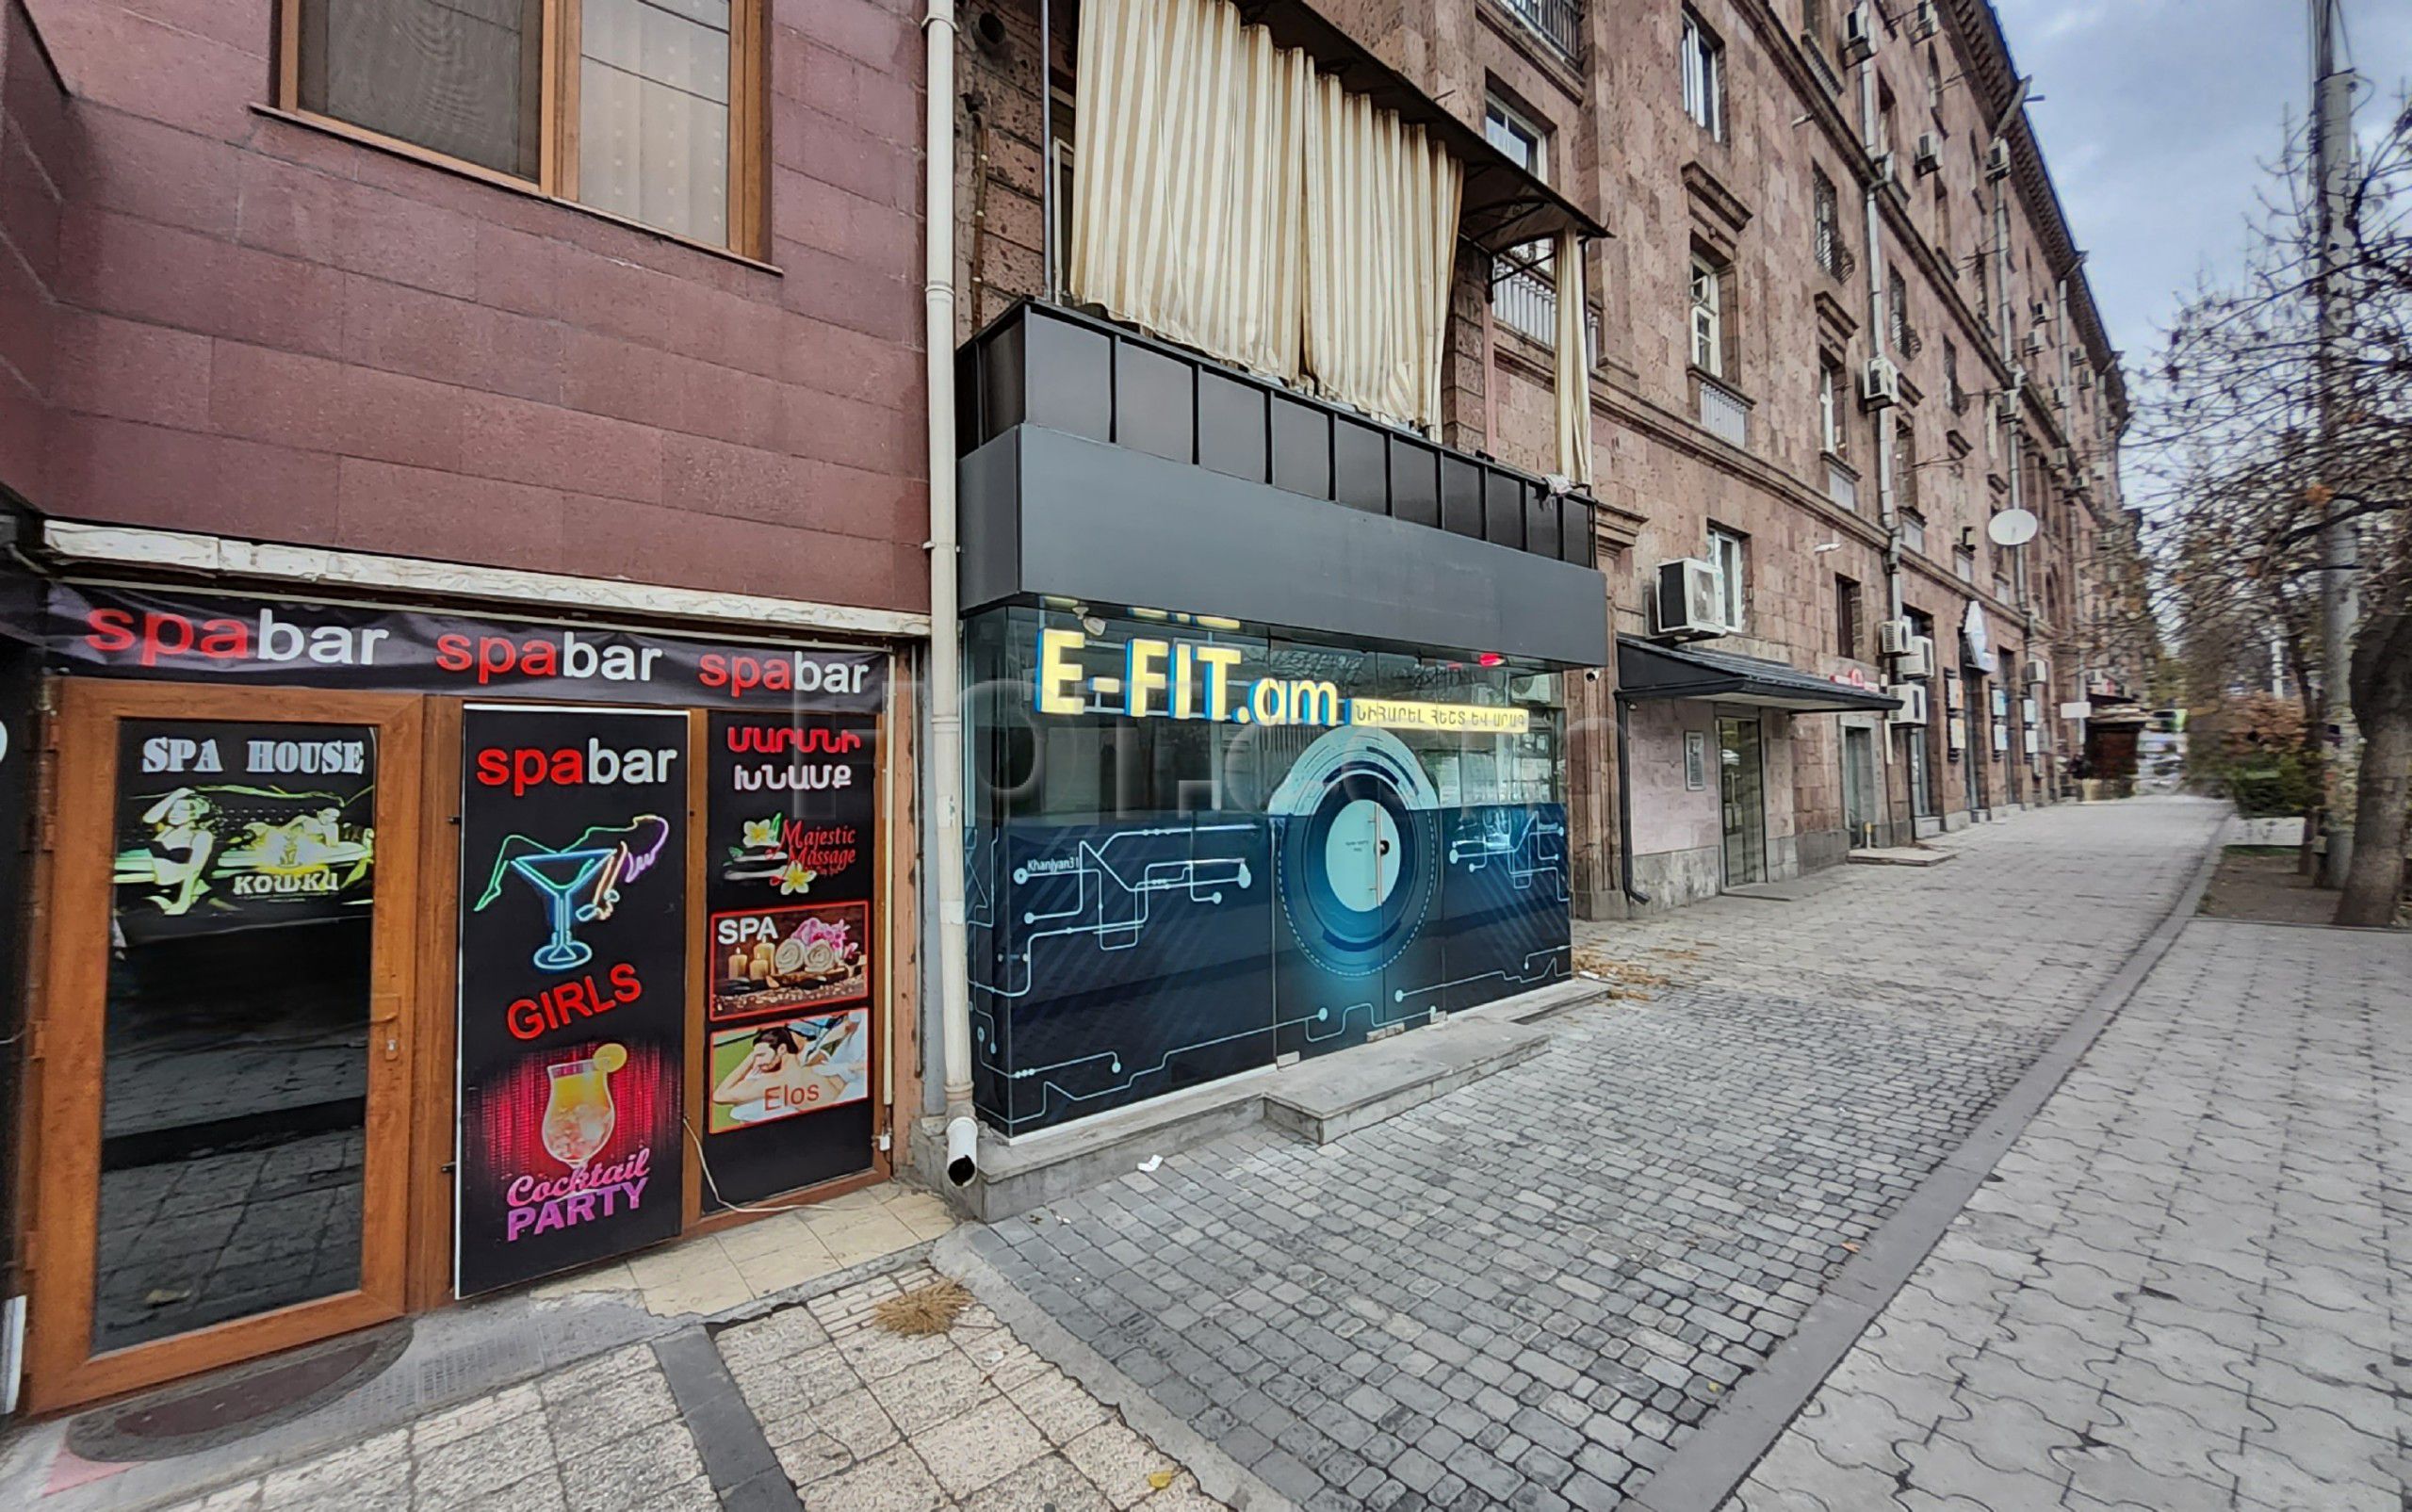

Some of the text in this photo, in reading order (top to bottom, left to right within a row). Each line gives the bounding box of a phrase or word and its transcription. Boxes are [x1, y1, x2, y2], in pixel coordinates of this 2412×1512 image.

[84, 608, 390, 667] spabar
[435, 632, 663, 684] spabar
[698, 650, 870, 697] spabar
[1036, 626, 1339, 726] E-FIT.am
[141, 736, 365, 774] SPA HOUSE
[726, 726, 861, 754] ՄԱՐՄՆԻ
[476, 737, 678, 796] spabar
[734, 764, 852, 791] ԽՆԱՄՔ
[776, 818, 857, 852] Majestic
[716, 918, 779, 946] SPA
[506, 963, 643, 1040] GIRLS
[763, 1081, 820, 1112] Elos
[506, 1147, 651, 1208] Cocktail
[506, 1177, 649, 1243] PARTY
